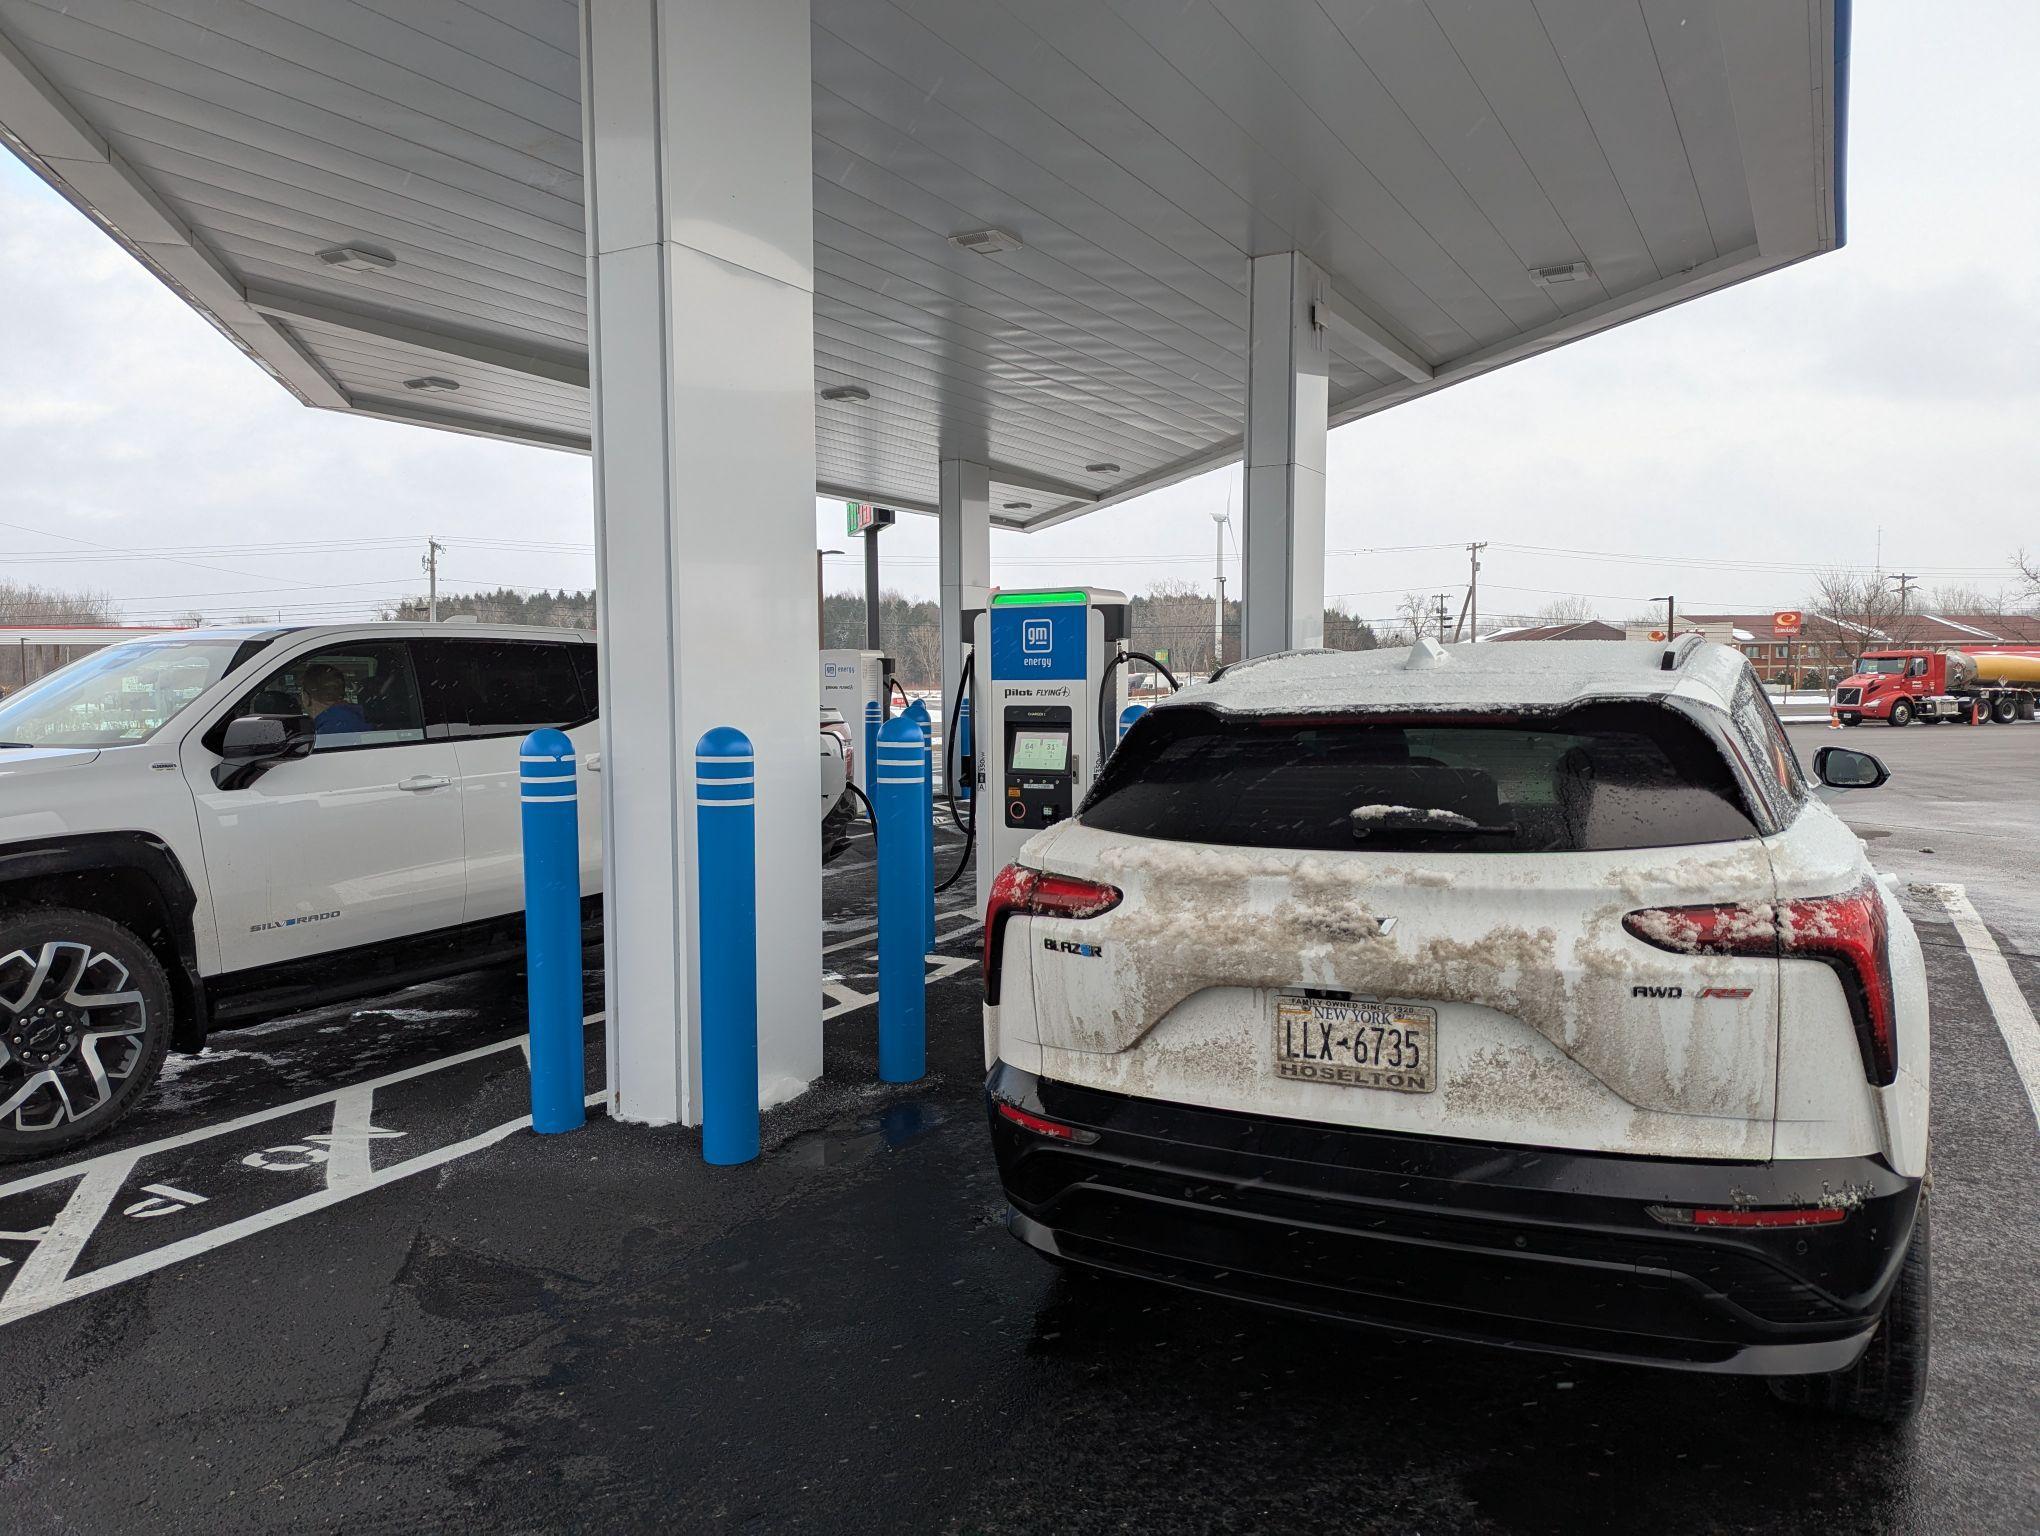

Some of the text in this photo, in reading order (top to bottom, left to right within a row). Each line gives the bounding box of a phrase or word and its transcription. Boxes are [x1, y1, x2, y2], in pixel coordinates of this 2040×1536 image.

[1028, 627, 1047, 645] gm
[1023, 658, 1052, 668] energy
[250, 911, 341, 933] SILVERADO
[1044, 938, 1102, 957] BLAZER
[1632, 986, 1754, 1000] AWD RS
[1291, 998, 1322, 1007] FAMILY
[1327, 1001, 1358, 1009] OWNED
[1361, 1003, 1390, 1012] SINCE
[1313, 1007, 1392, 1025] NEW YORK
[1354, 1026, 1420, 1069] 6735
[1280, 1063, 1426, 1090] HOSELTON
